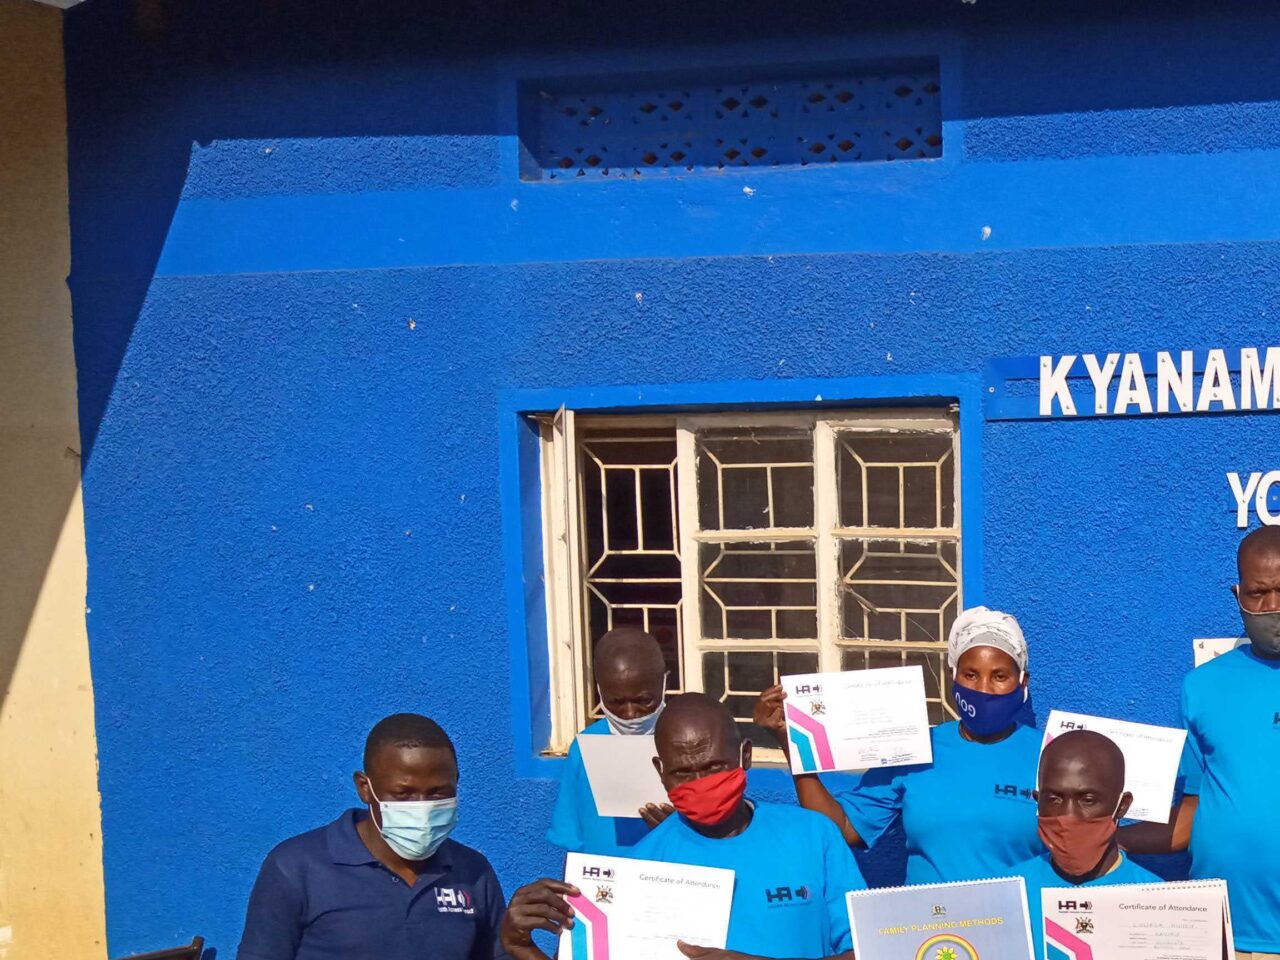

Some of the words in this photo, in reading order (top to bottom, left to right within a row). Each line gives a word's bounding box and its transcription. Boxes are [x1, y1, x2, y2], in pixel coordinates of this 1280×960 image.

[1118, 903, 1156, 911] Certificate
[1158, 903, 1167, 911] of
[1168, 904, 1208, 912] Attendance
[879, 926, 908, 935] FAMILY
[911, 921, 957, 931] PLANNING
[959, 917, 1004, 928] METHODS
